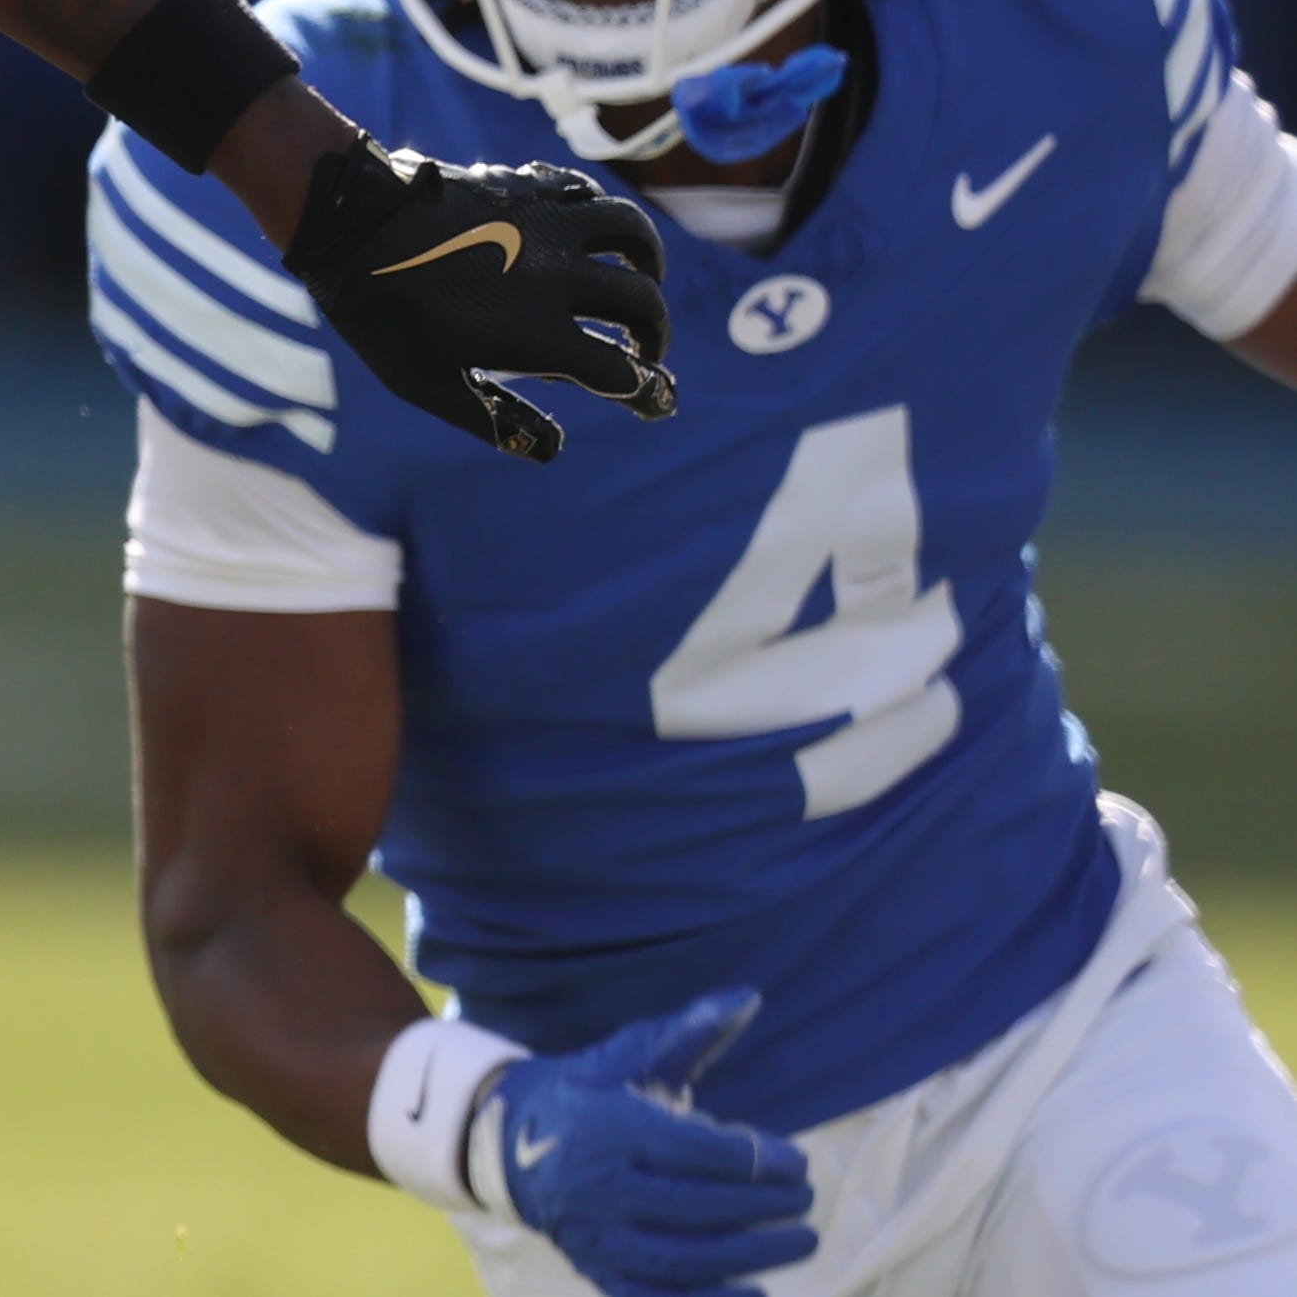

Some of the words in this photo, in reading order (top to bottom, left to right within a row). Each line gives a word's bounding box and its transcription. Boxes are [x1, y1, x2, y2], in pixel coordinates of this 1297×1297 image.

[742, 287, 806, 341] Y
[649, 402, 965, 822] 4
[1110, 1135, 1270, 1247] Y
